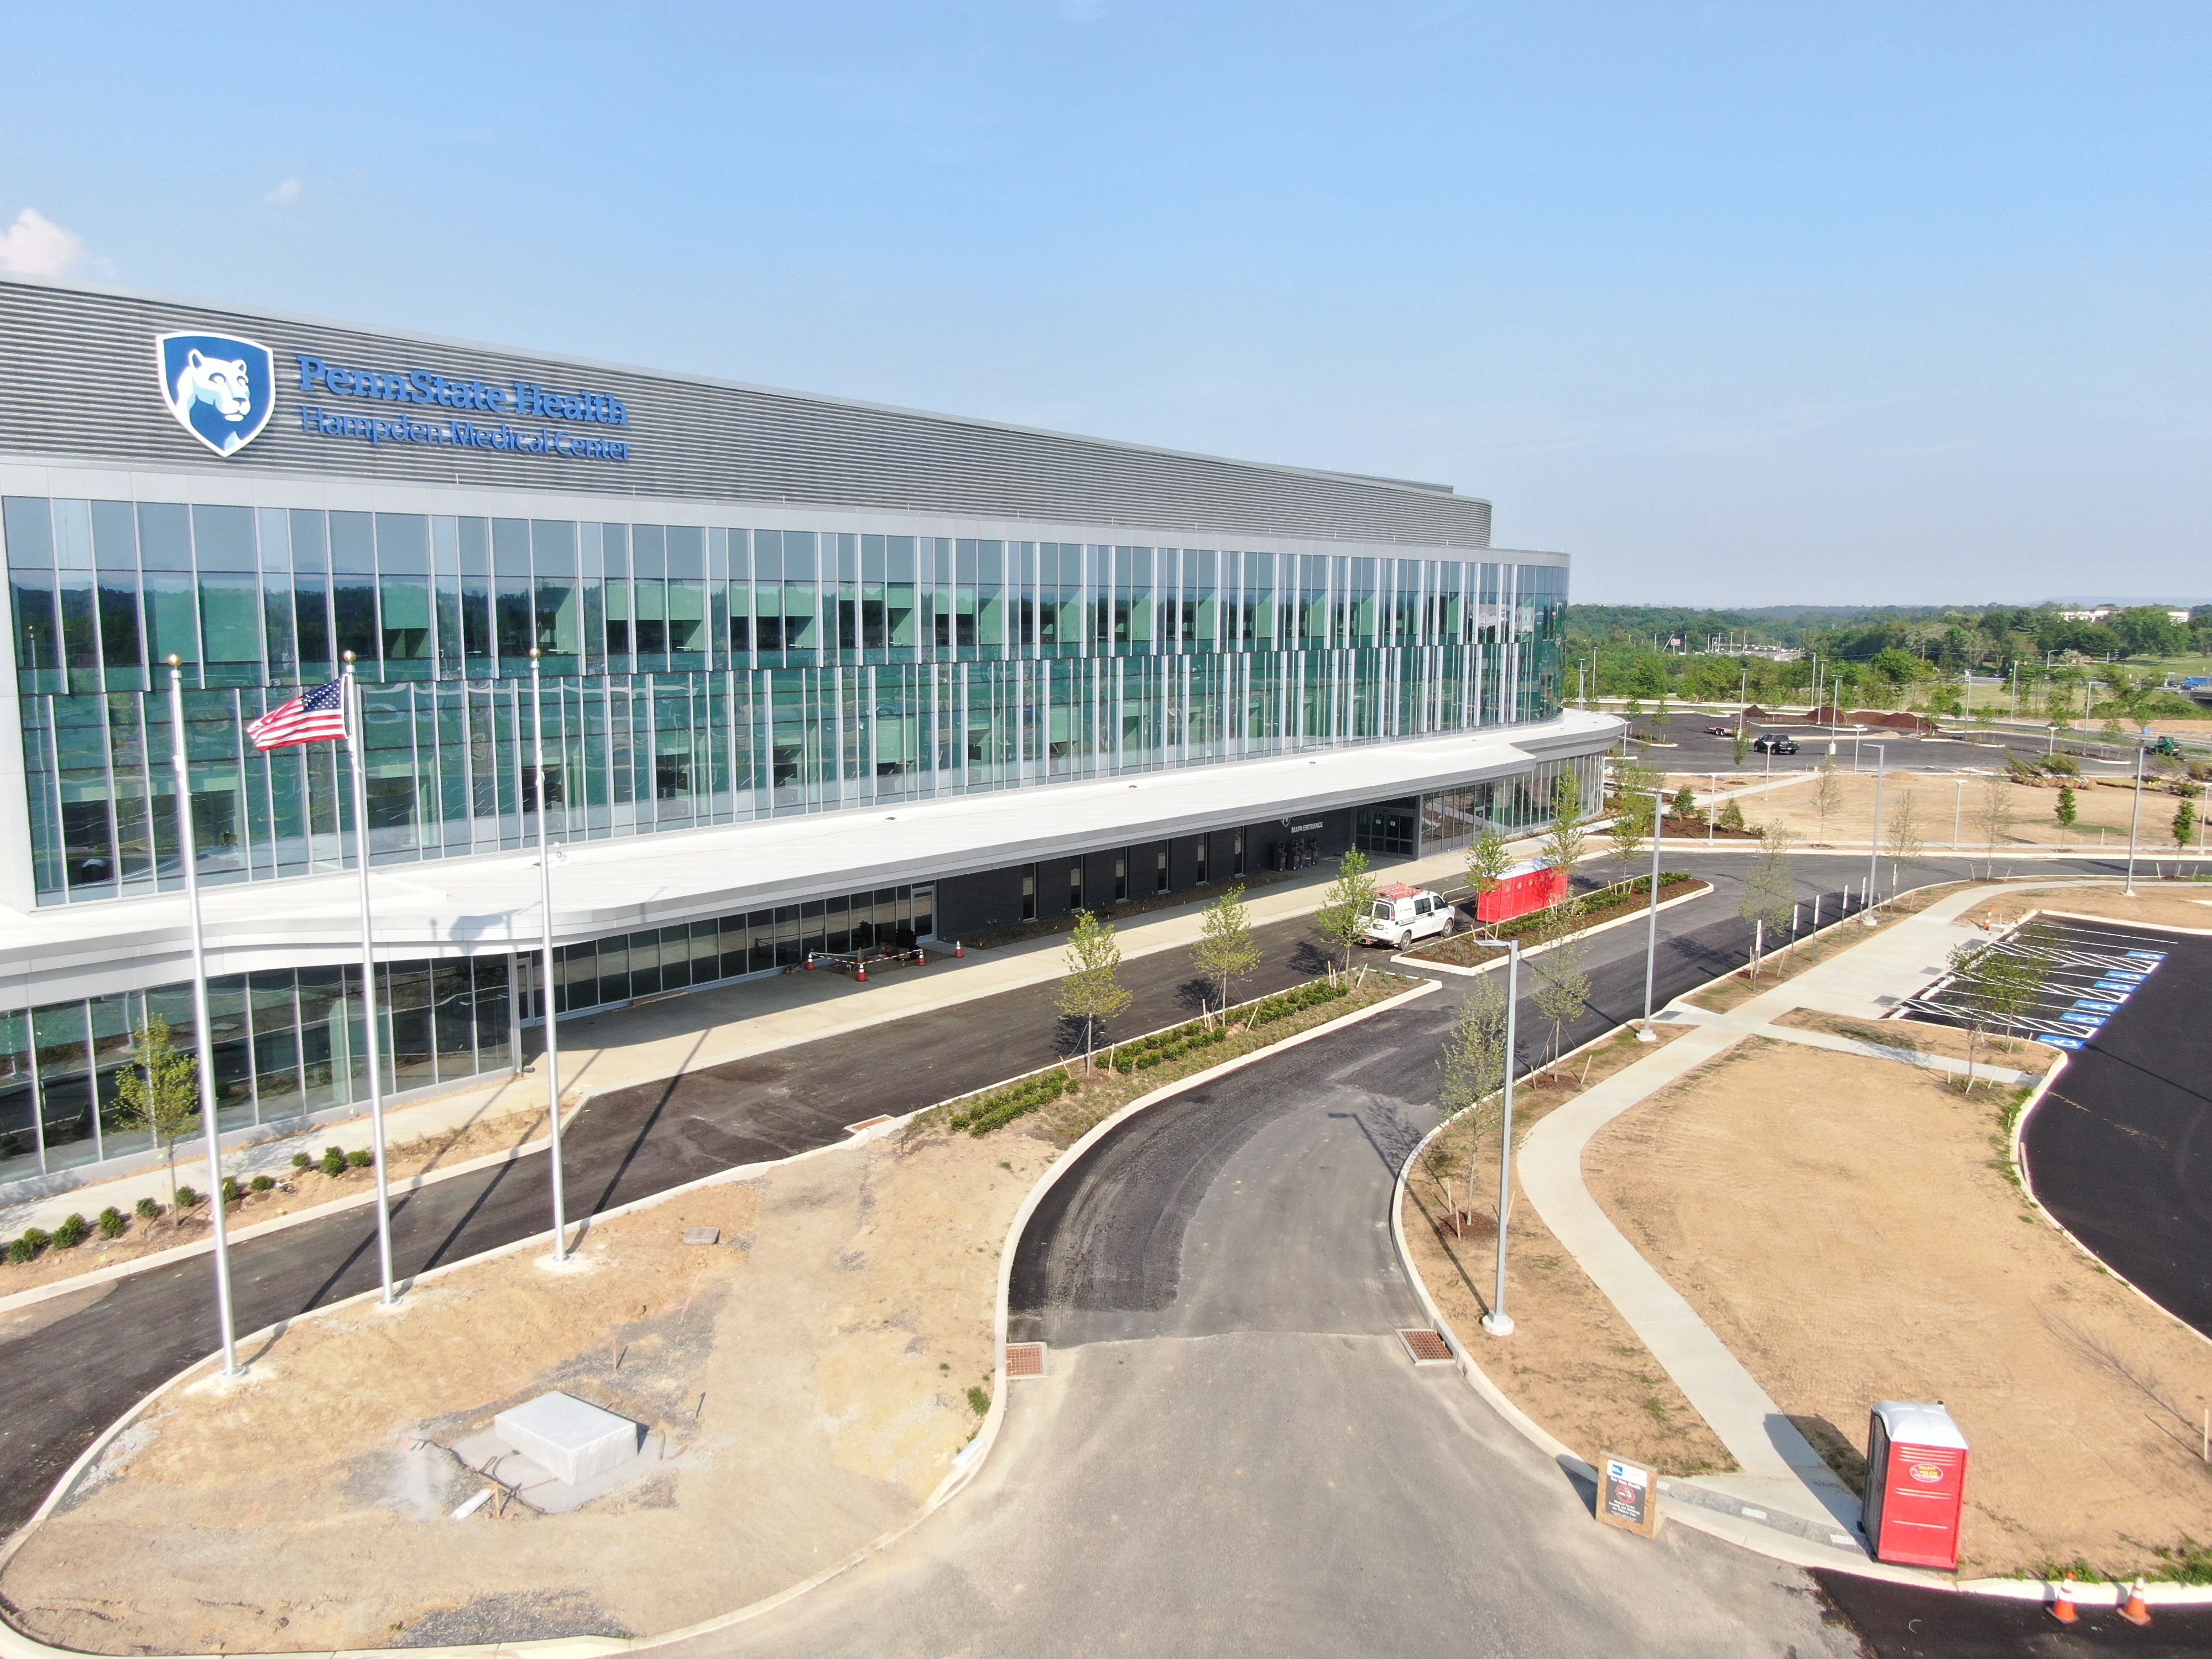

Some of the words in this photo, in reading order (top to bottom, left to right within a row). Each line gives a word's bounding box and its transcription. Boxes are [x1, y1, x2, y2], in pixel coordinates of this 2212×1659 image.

[515, 382, 629, 425] Health
[301, 405, 443, 446] Hampden
[450, 420, 549, 453] Medical
[554, 430, 629, 460] Center
